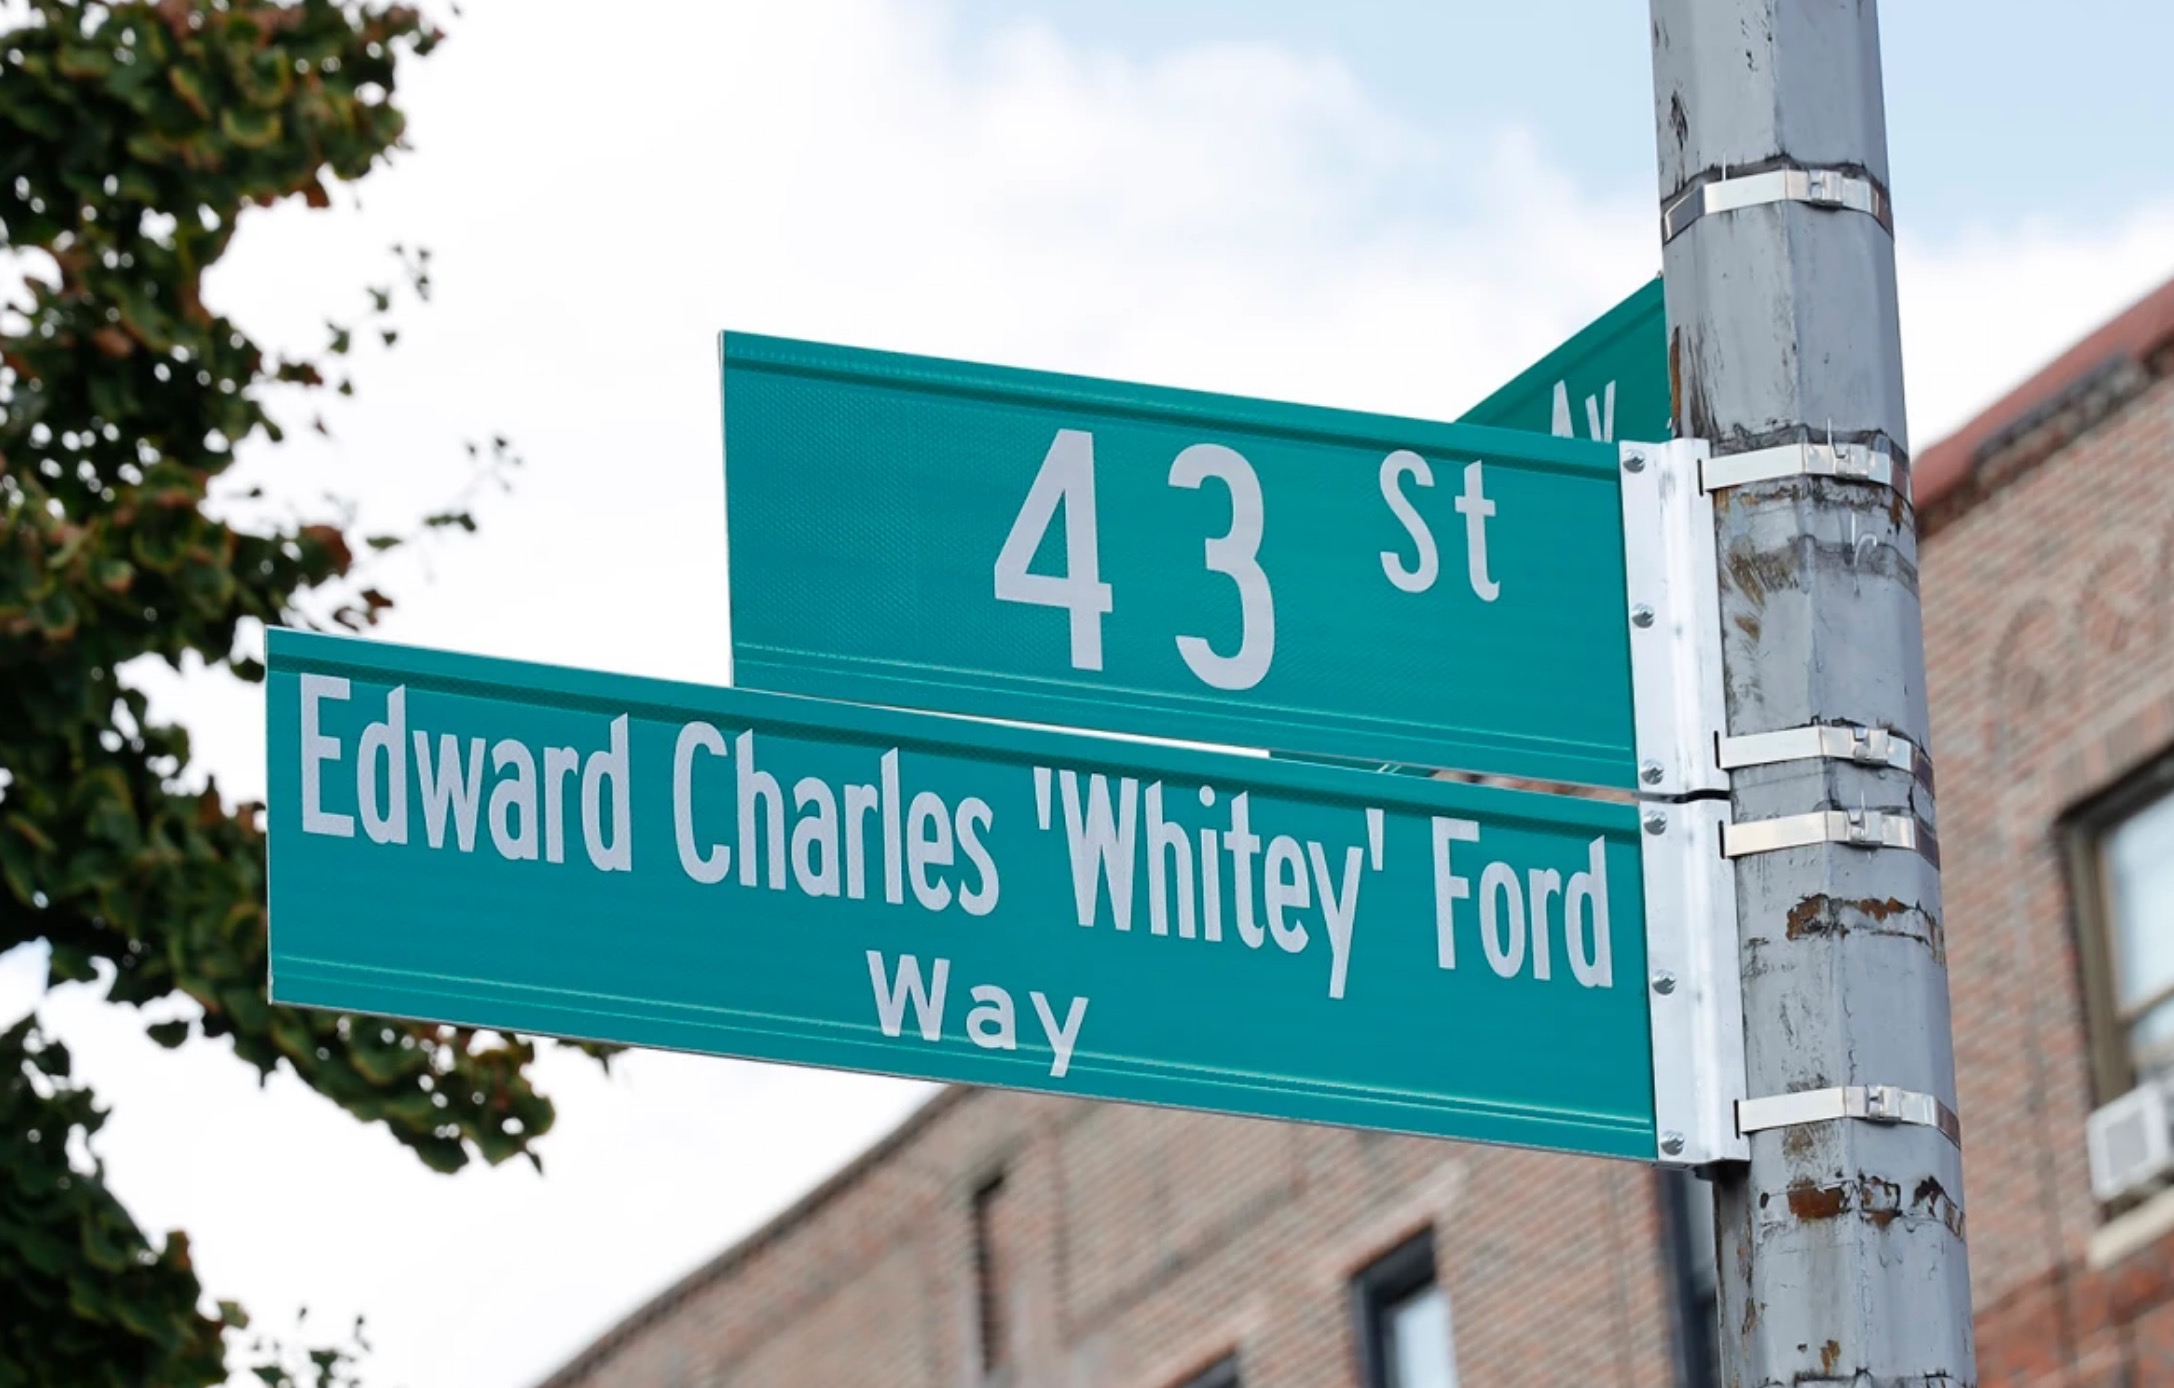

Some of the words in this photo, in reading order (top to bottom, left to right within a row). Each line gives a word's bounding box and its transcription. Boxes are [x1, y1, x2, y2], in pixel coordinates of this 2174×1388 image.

[994, 429, 1275, 690] 43
[1379, 449, 1500, 602] St
[300, 672, 632, 871] Edward
[673, 721, 999, 916] Charles
[1033, 766, 1384, 999] 'Whitey'
[1432, 816, 1613, 988] Ford
[866, 950, 1089, 1078] Way
